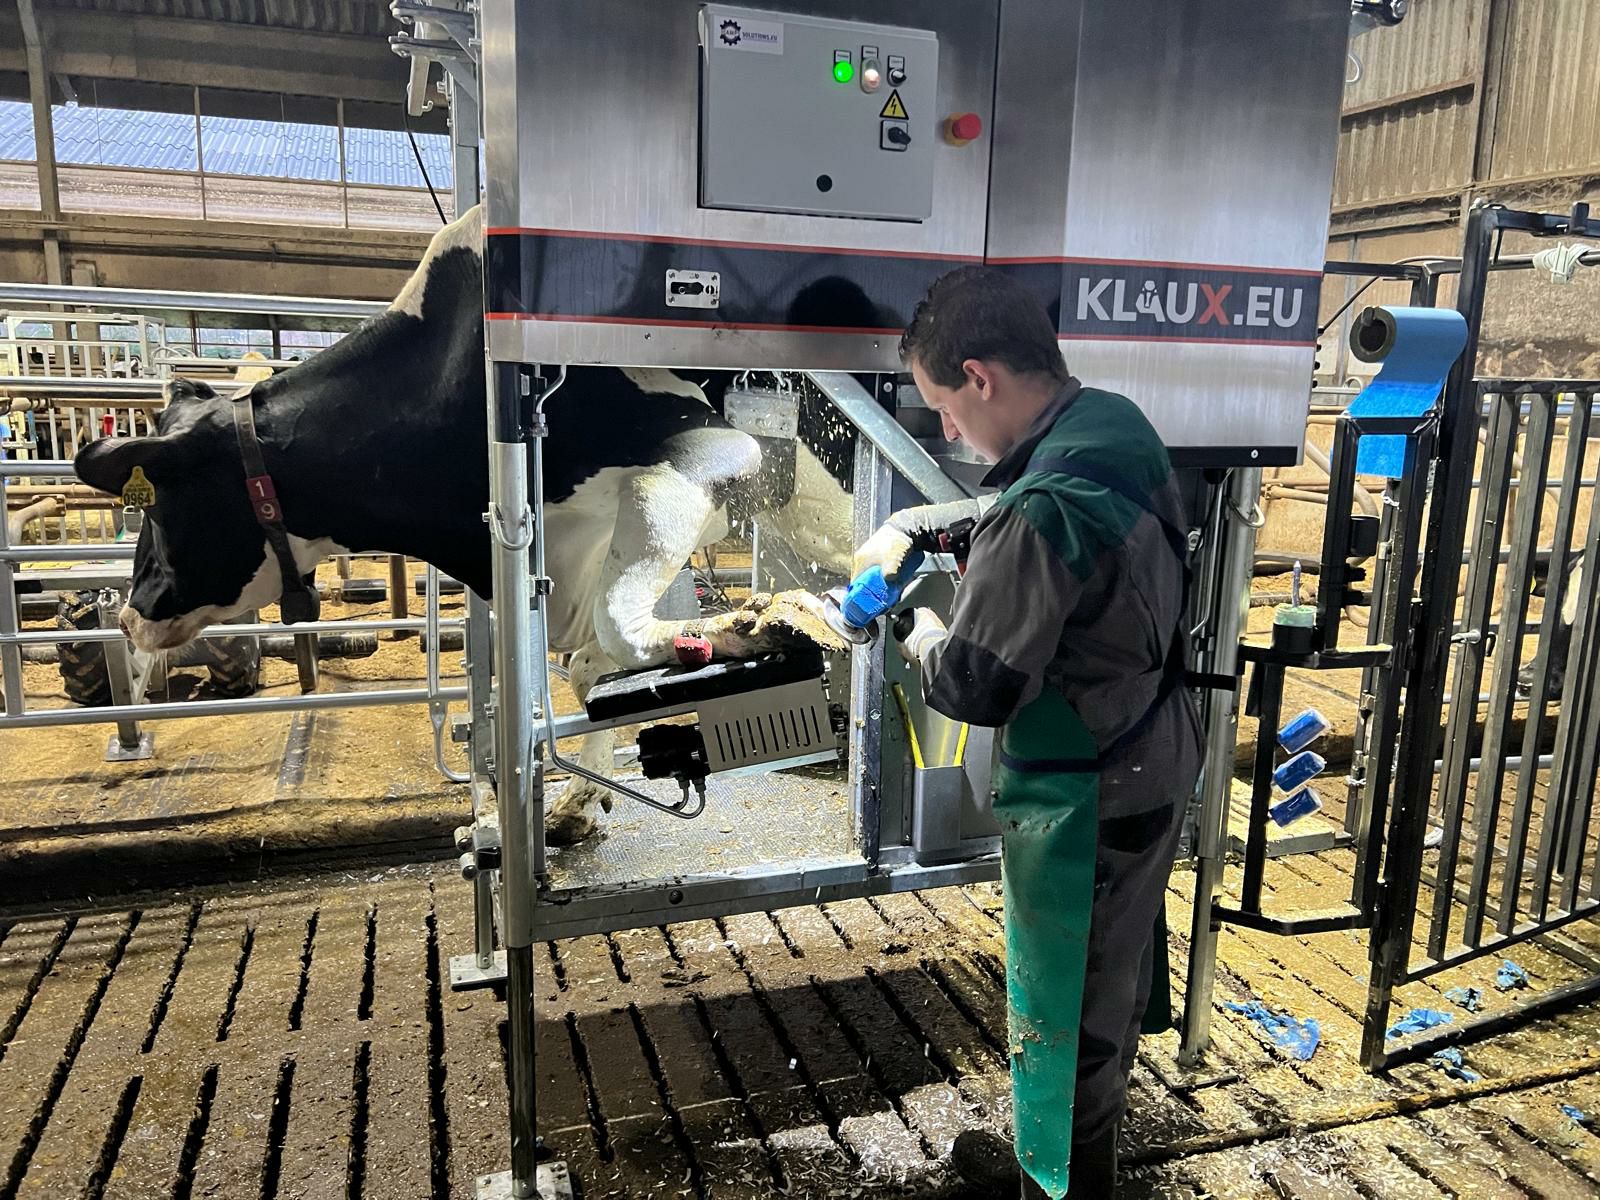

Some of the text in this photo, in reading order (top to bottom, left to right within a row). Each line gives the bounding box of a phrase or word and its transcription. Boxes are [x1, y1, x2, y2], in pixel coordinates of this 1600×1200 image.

[1077, 277, 1303, 328] KLAUX.EU
[255, 480, 264, 497] 1
[124, 492, 151, 506] 0964
